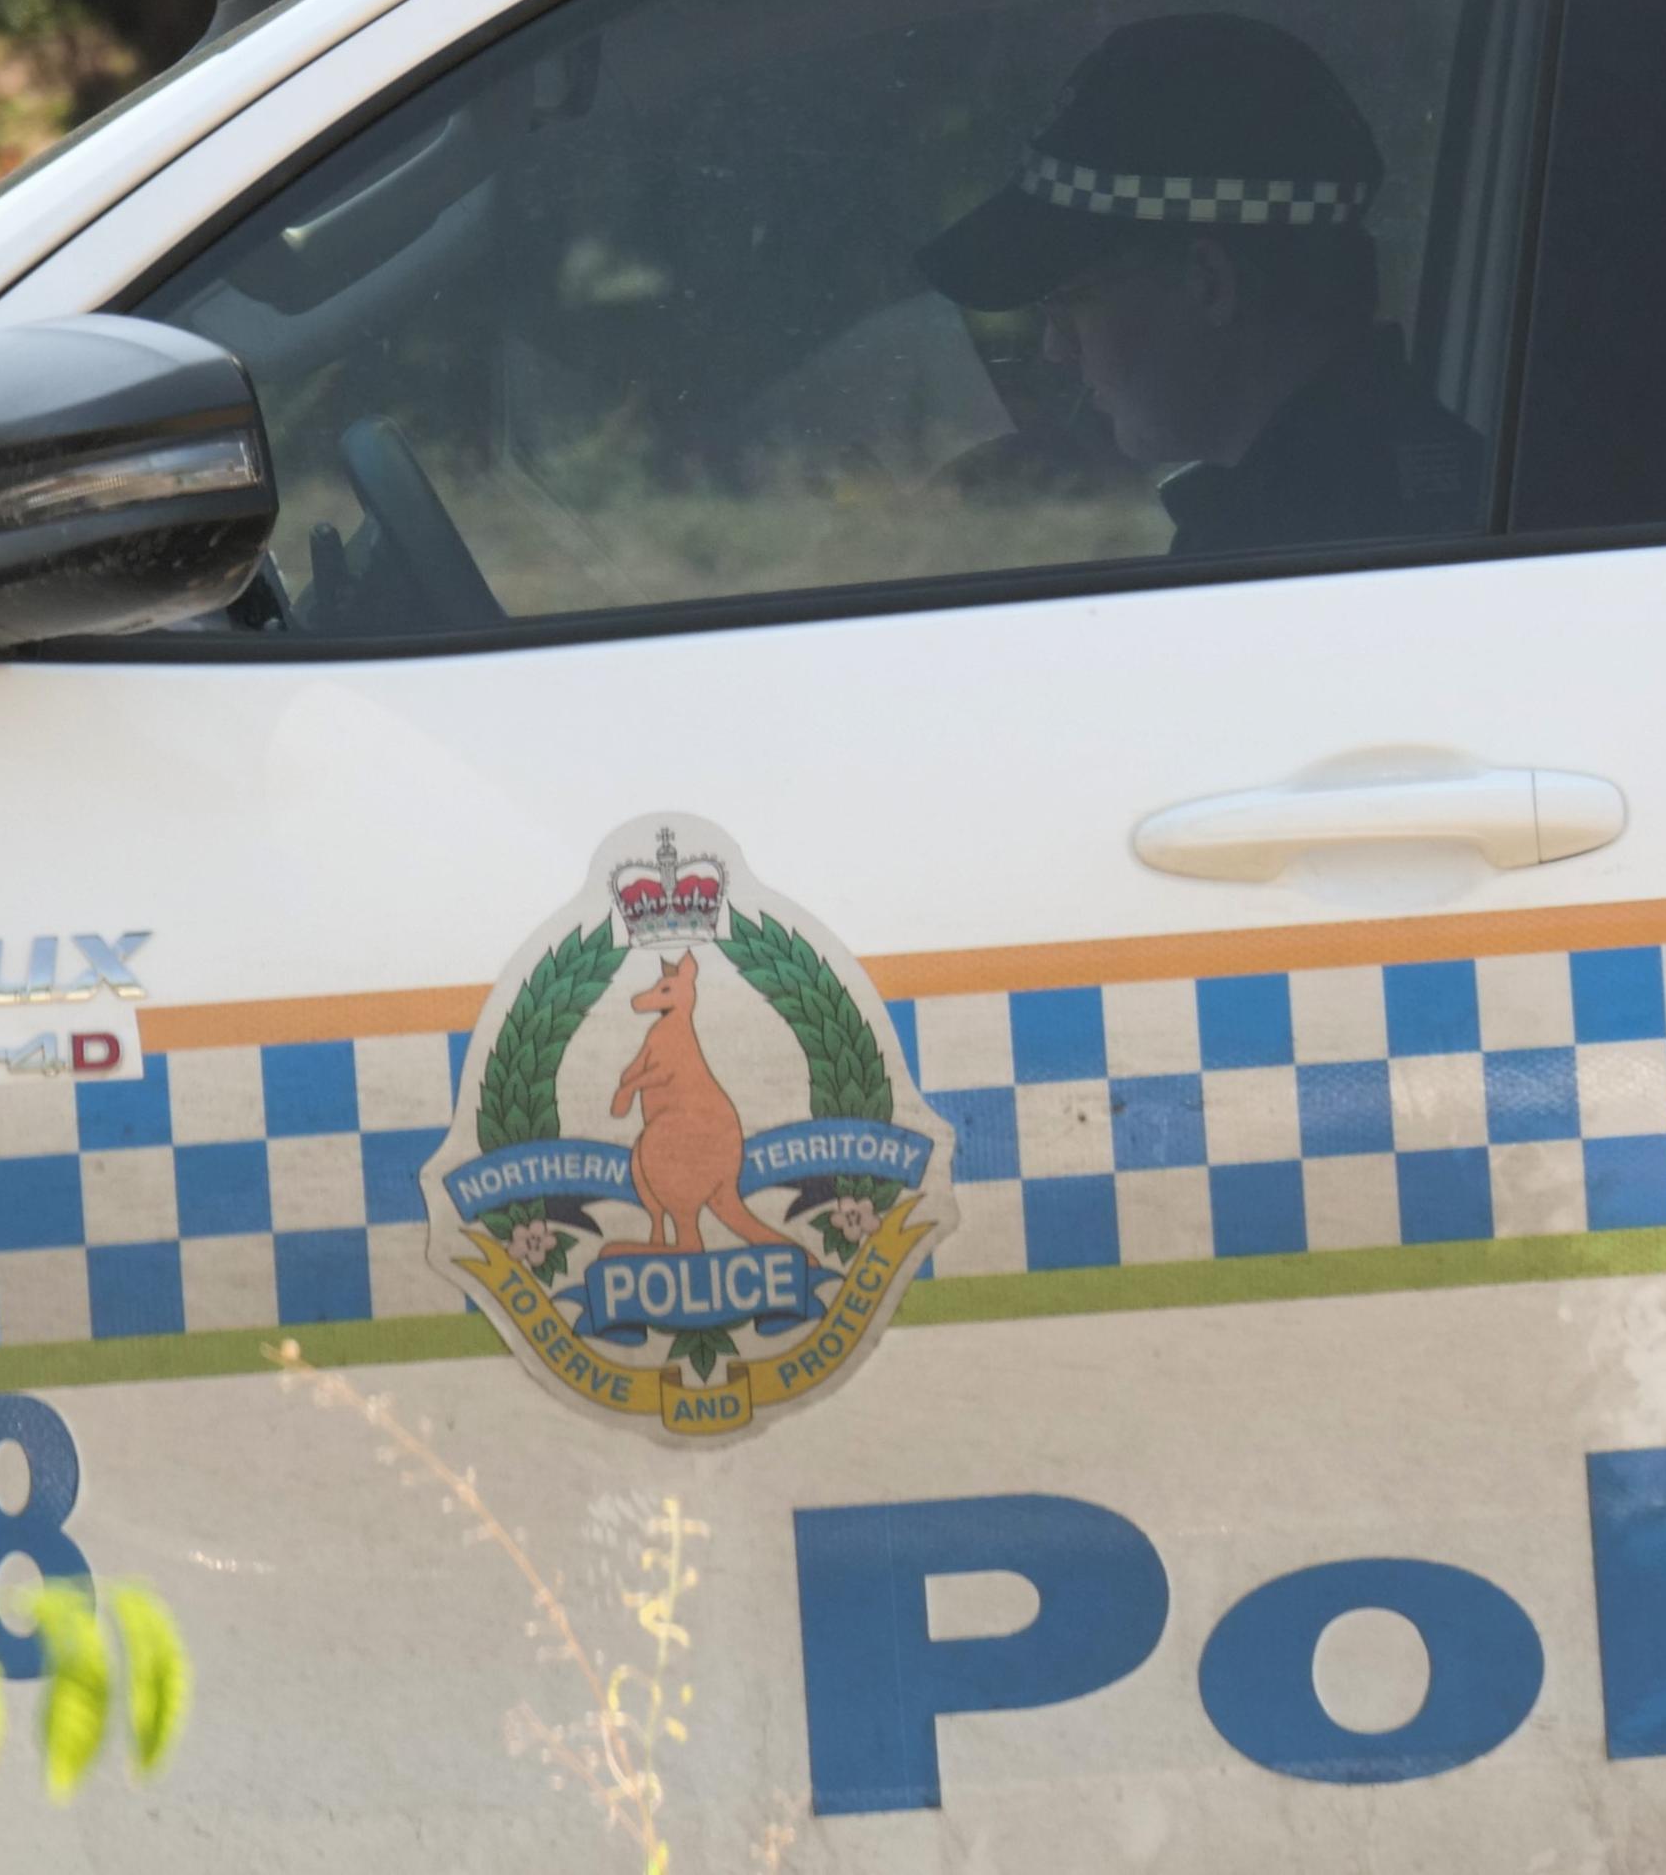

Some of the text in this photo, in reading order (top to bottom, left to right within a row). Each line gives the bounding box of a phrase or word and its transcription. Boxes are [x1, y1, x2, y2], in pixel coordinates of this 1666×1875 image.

[457, 1131, 923, 1204] NORTHERN TERRITORY
[602, 1253, 798, 1320] POLICE
[499, 1247, 895, 1423] TO SERVE AND PROTECT
